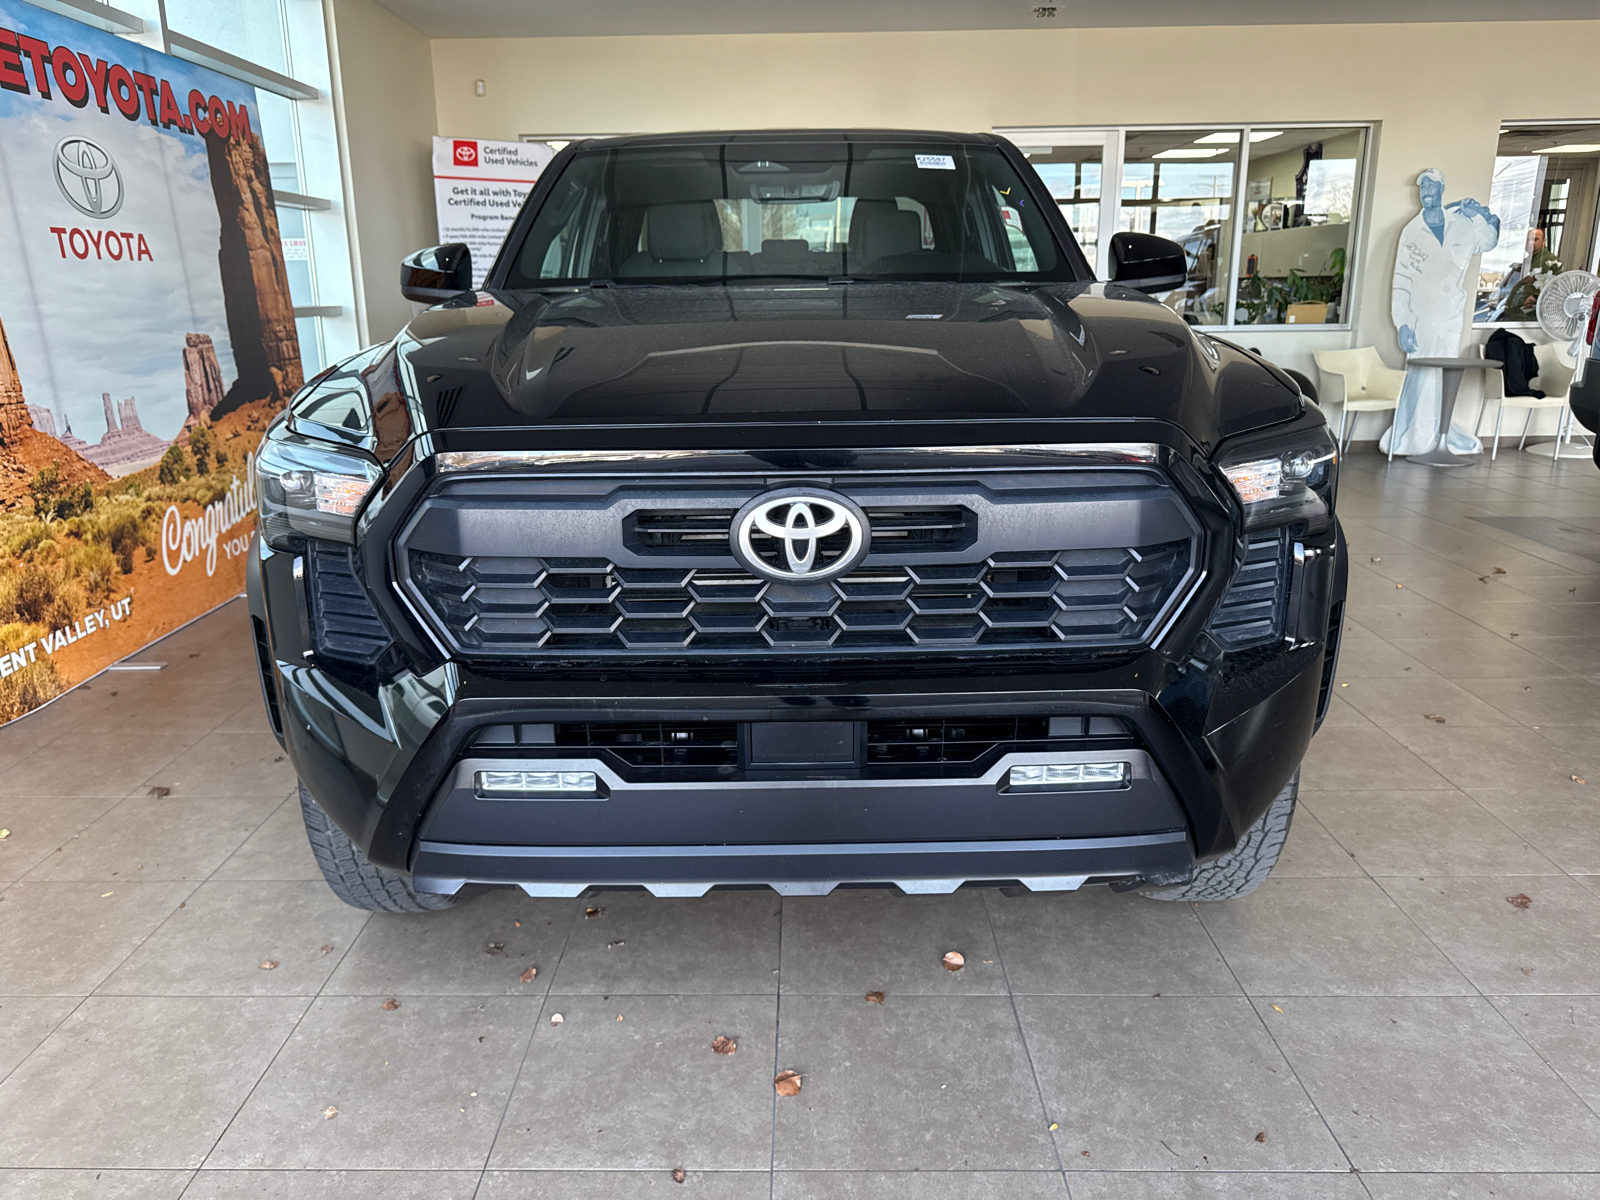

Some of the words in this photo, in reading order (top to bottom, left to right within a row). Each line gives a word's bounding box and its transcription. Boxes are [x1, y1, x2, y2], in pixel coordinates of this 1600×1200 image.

[483, 146, 518, 156] Certified
[484, 156, 505, 165] Used
[506, 157, 538, 167] Vehicles
[452, 186, 468, 196] Get
[470, 187, 477, 196] it
[479, 187, 490, 196] all
[492, 187, 511, 198] with
[447, 197, 487, 207] Certified
[488, 198, 510, 208] Used
[470, 212, 499, 222] Program
[49, 226, 154, 262] TOYOTA
[222, 534, 249, 560] YOU
[0, 640, 37, 679] ENT
[40, 608, 110, 656] VALLEY,
[110, 596, 131, 621] UT
